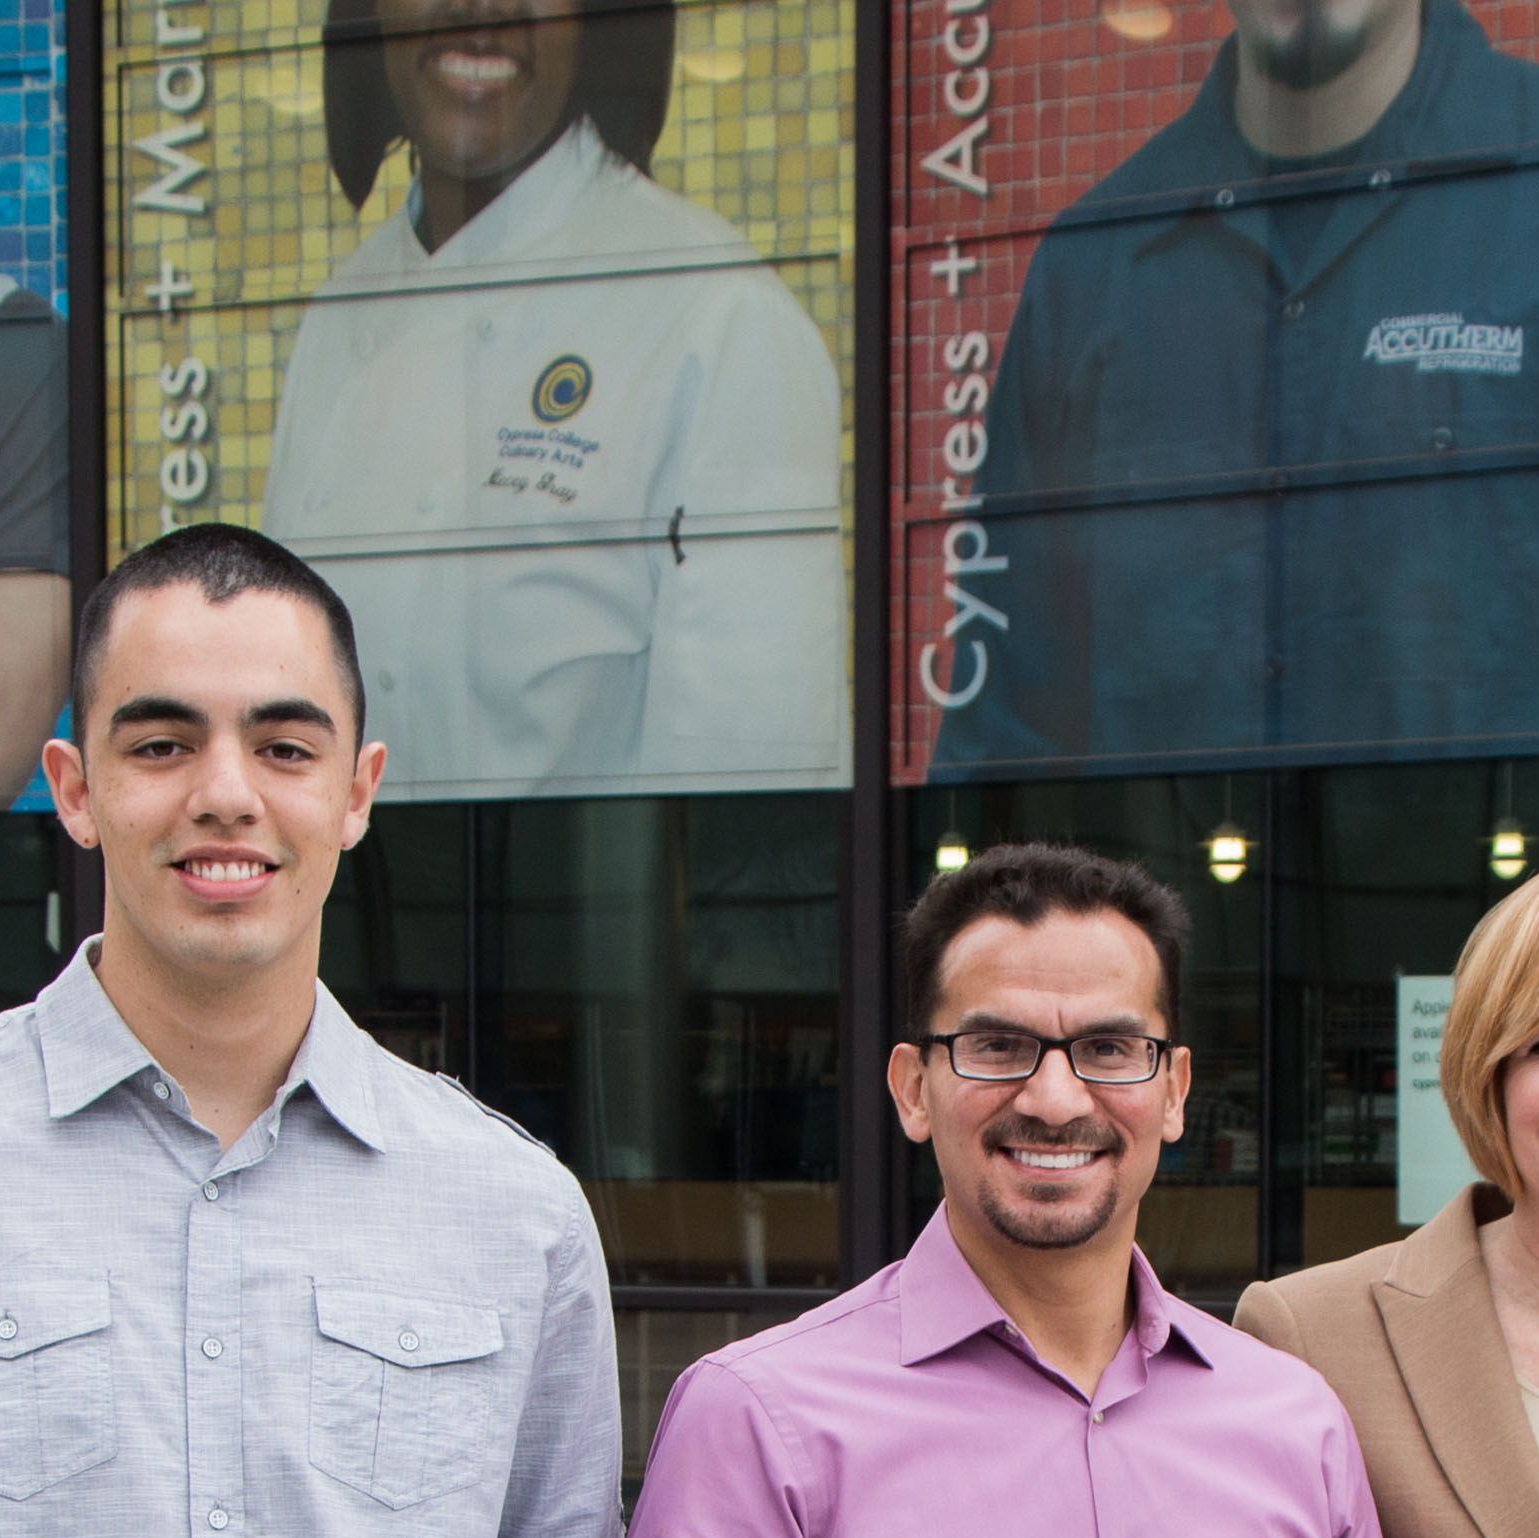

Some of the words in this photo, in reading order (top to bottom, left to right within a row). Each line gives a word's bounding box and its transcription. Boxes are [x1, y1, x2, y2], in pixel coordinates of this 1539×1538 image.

[920, 0, 990, 196] Acc
[1363, 324, 1523, 360] ACCUTHERM
[160, 357, 208, 538] ress
[547, 428, 600, 454] College
[551, 448, 583, 469] Arts
[920, 331, 1009, 709] Cypress
